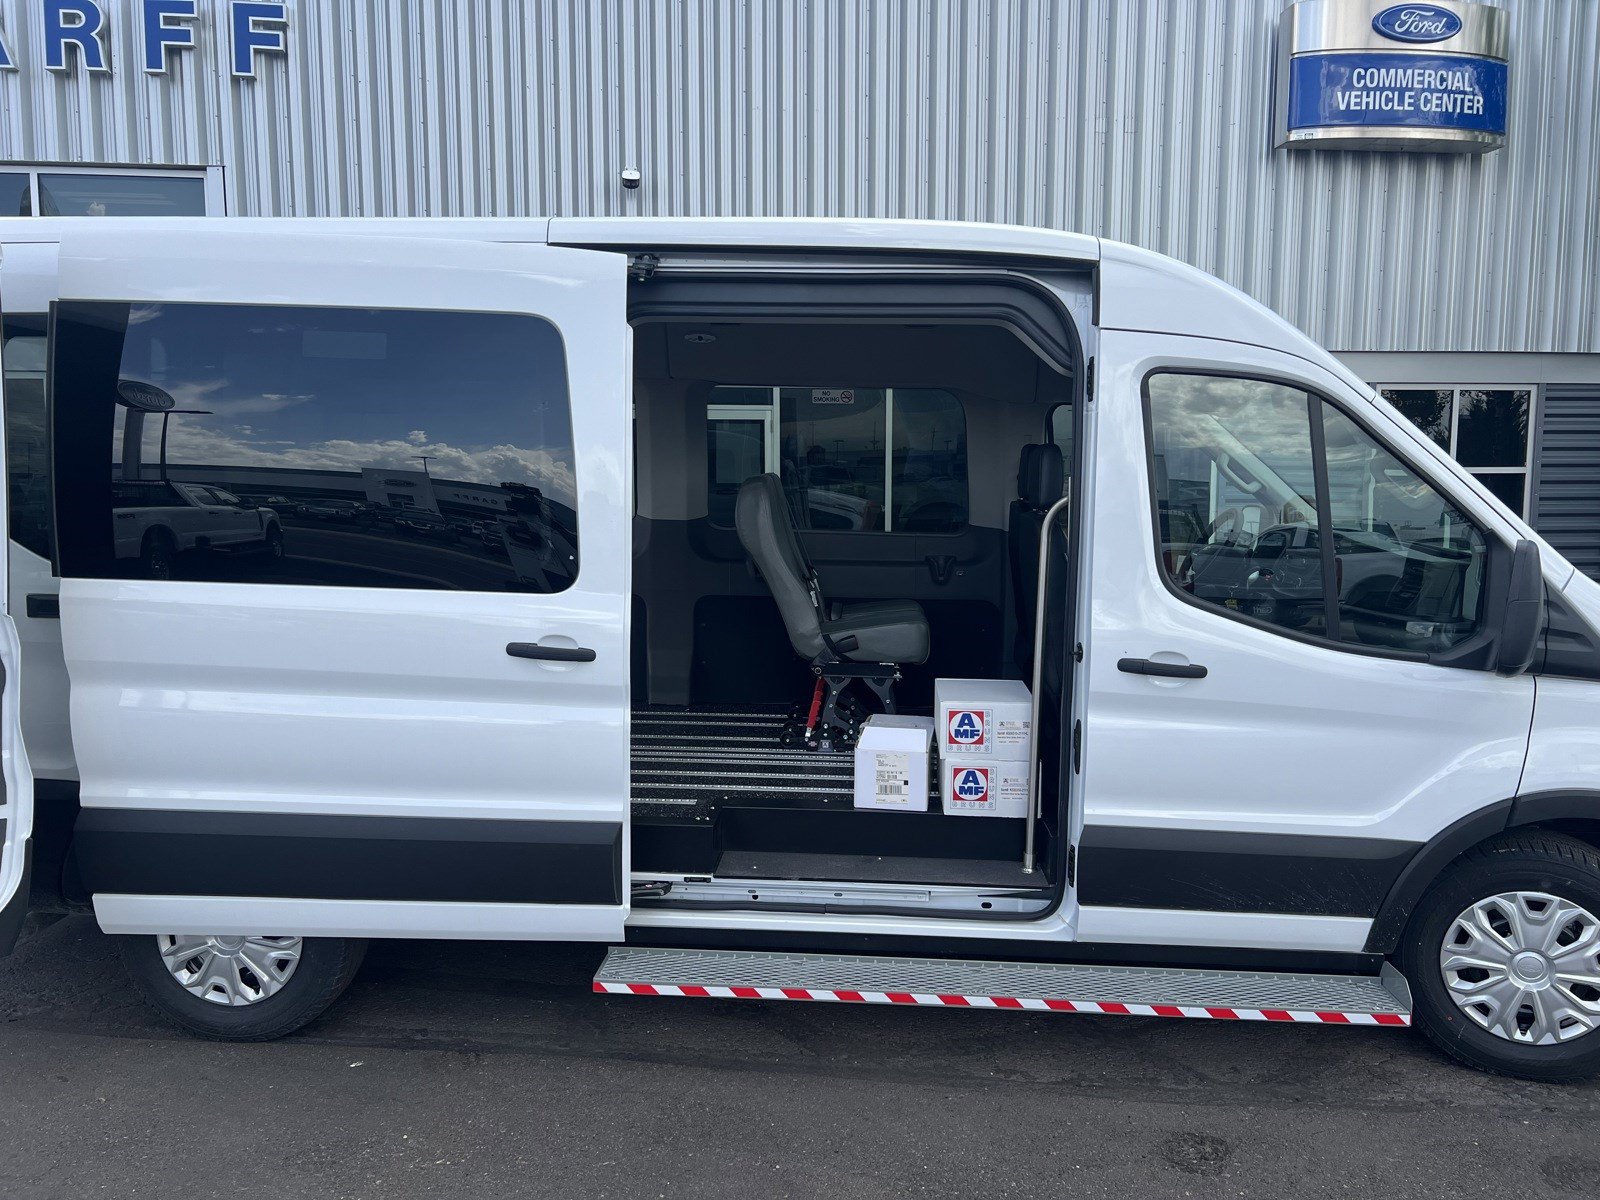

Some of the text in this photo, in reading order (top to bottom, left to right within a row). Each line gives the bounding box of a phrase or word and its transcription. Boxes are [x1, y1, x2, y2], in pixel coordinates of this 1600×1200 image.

[1394, 9, 1448, 35] Ford
[0, 0, 289, 80] RFF
[1352, 67, 1473, 92] COMMERCIAL
[1337, 91, 1484, 115] VEHICLE CENTER
